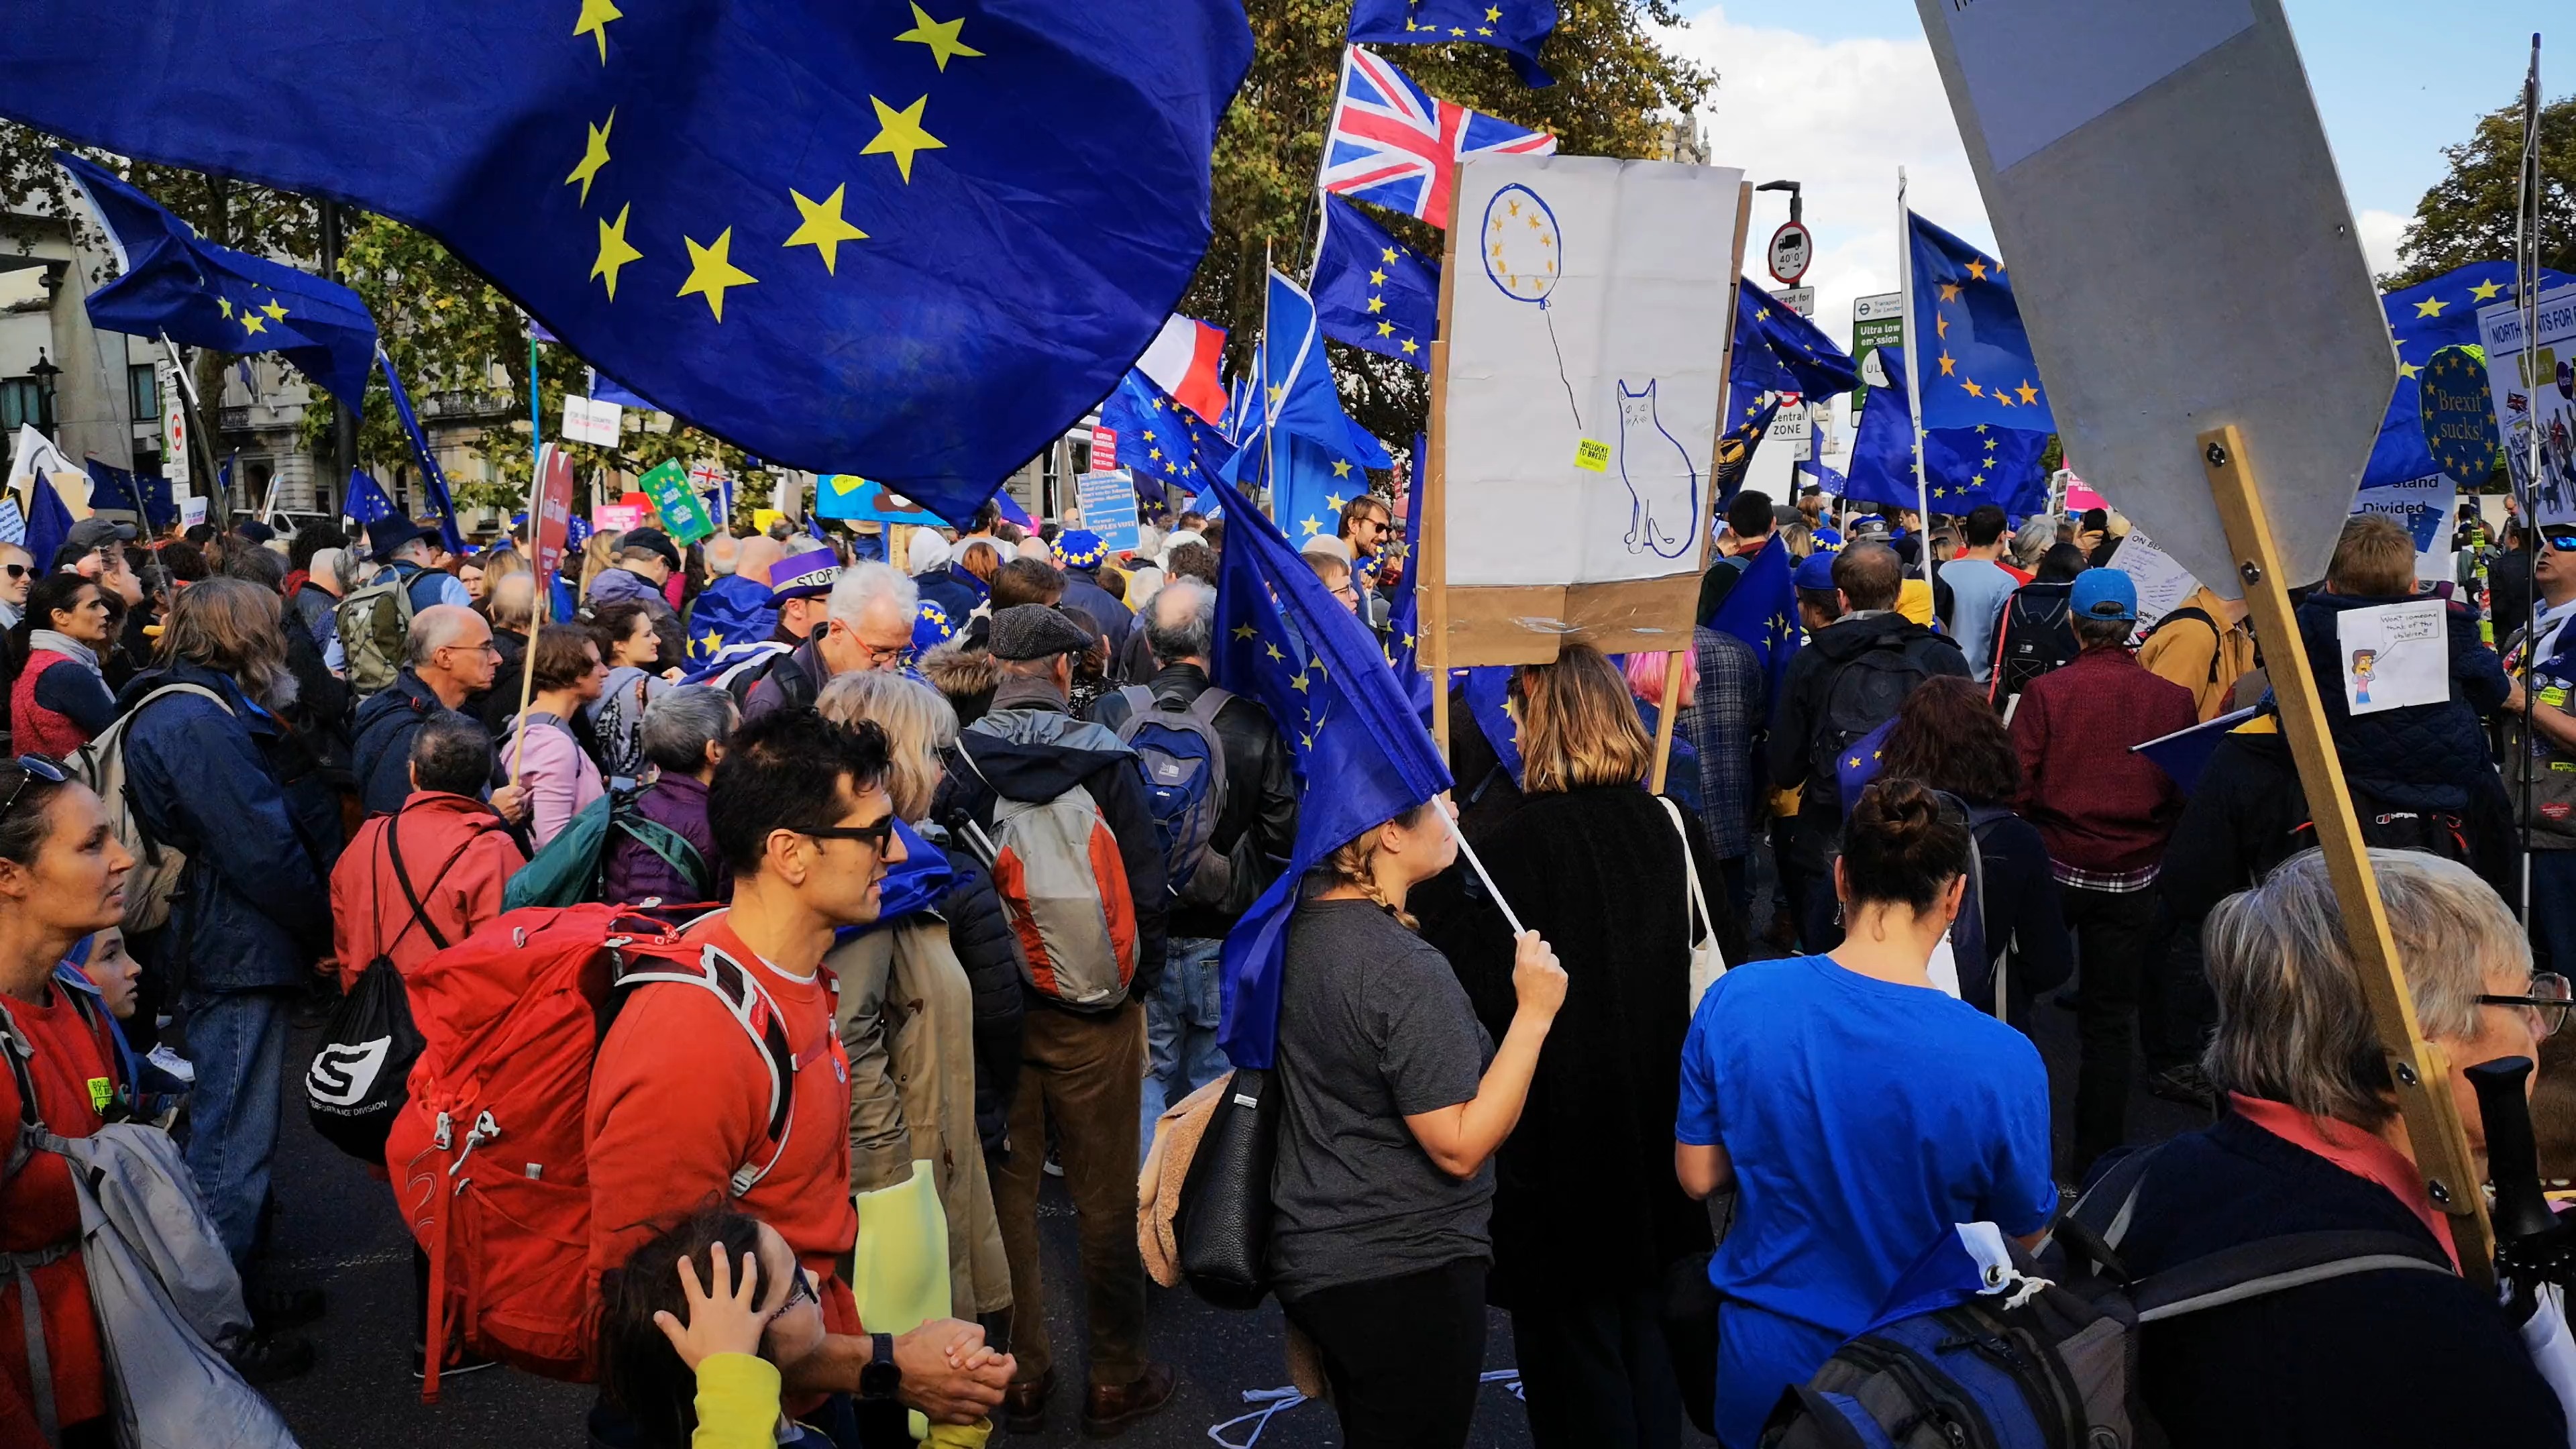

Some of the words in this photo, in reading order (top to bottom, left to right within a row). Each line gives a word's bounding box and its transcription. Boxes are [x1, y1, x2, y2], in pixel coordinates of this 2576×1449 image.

[1799, 292, 1809, 301] for
[1860, 325, 1882, 335] Ultra
[1884, 324, 1900, 333] low
[2491, 321, 2522, 345] NORTH
[2553, 308, 2573, 329] FOR
[2437, 389, 2482, 412] Brexit
[1774, 424, 1801, 435] ZONE
[2440, 417, 2484, 441] sucks!
[2363, 502, 2426, 514] Divided
[2132, 535, 2146, 545] ON
[797, 569, 833, 586] STOP
[354, 1100, 388, 1116] DIVISION
